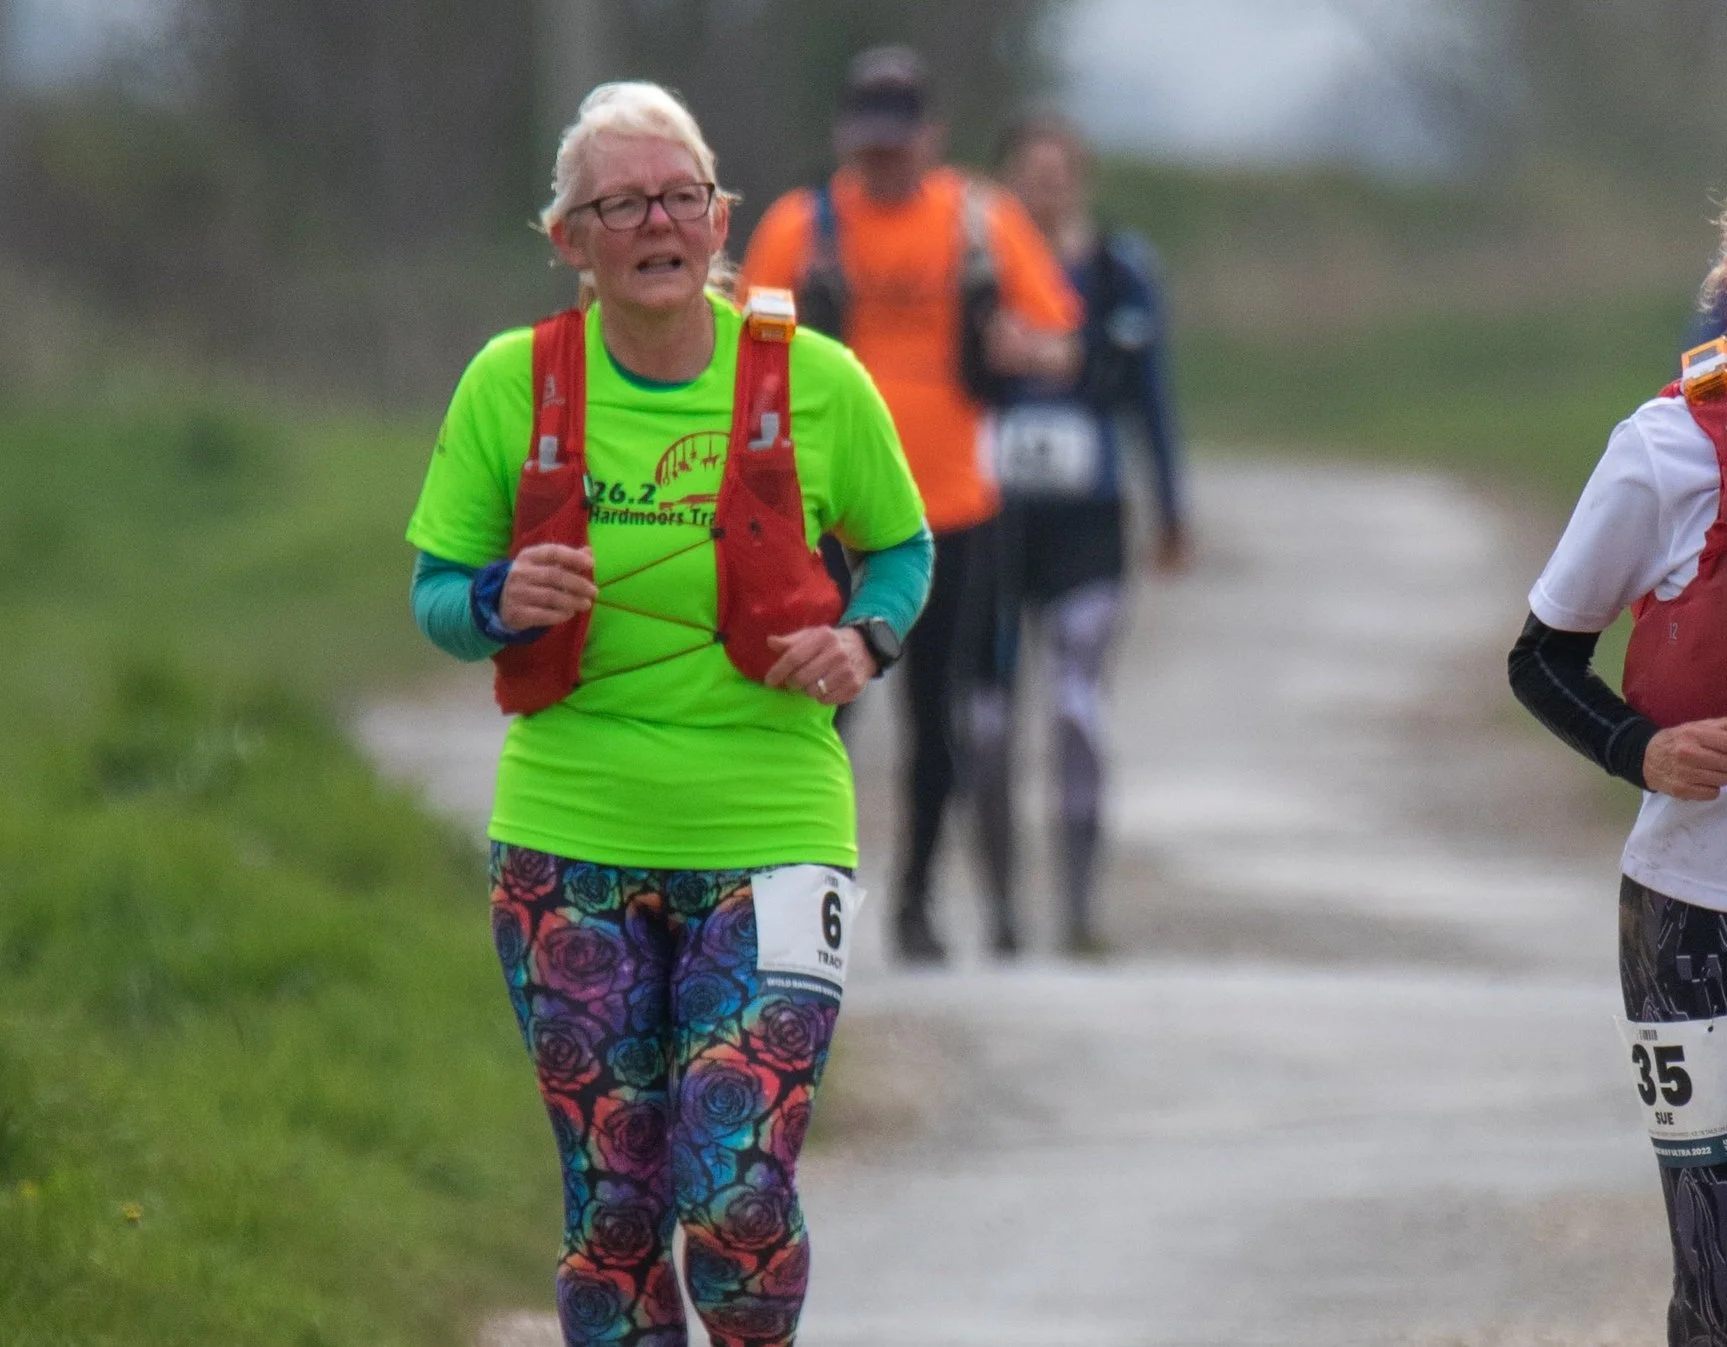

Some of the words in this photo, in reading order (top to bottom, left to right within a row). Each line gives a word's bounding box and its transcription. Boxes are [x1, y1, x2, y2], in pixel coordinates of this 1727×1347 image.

[592, 480, 656, 505] 26.2
[589, 505, 684, 526] Hardmoors
[821, 890, 842, 950] 6
[1631, 1043, 1693, 1107] 35
[1655, 1112, 1674, 1125] SUE
[1691, 1146, 1712, 1156] 2022
